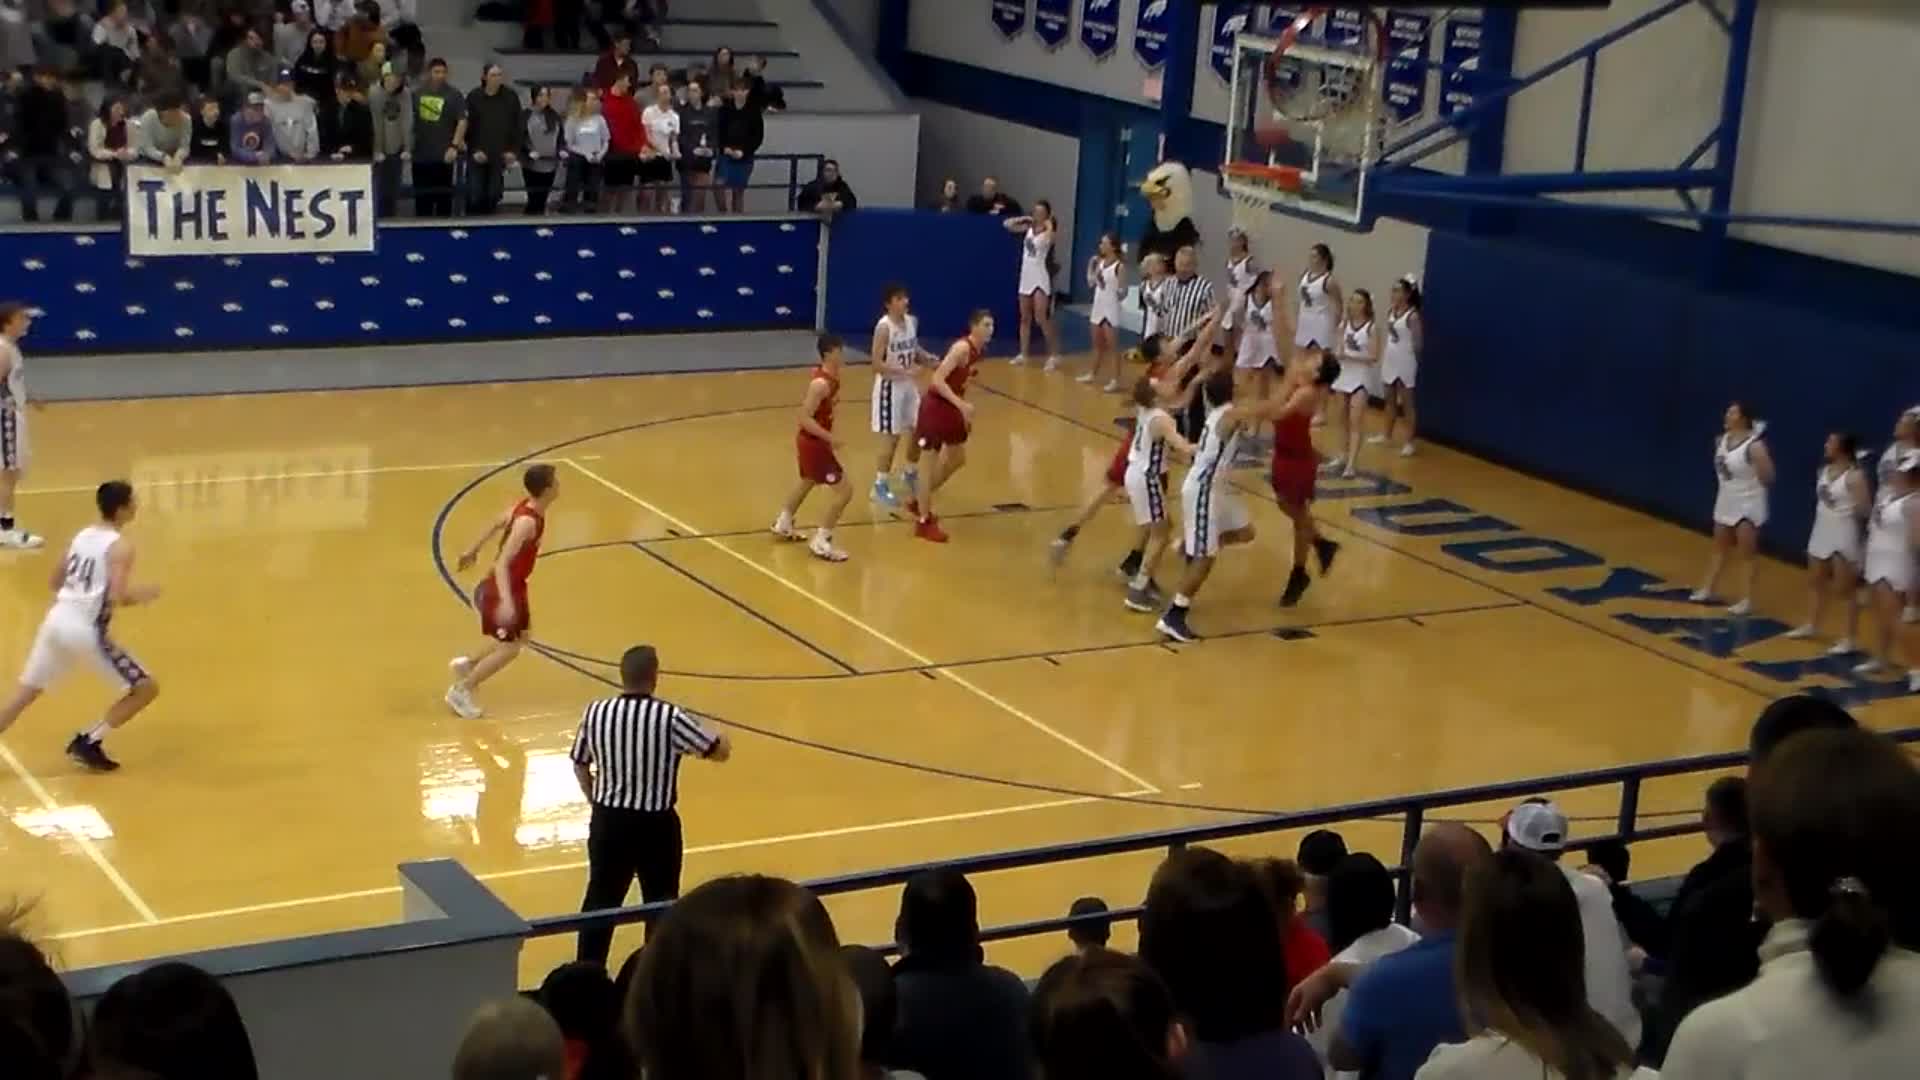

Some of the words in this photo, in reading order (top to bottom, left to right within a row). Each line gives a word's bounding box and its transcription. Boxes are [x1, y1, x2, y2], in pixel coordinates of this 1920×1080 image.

[137, 179, 229, 240] THE
[245, 177, 365, 240] NEST
[65, 553, 96, 593] 24
